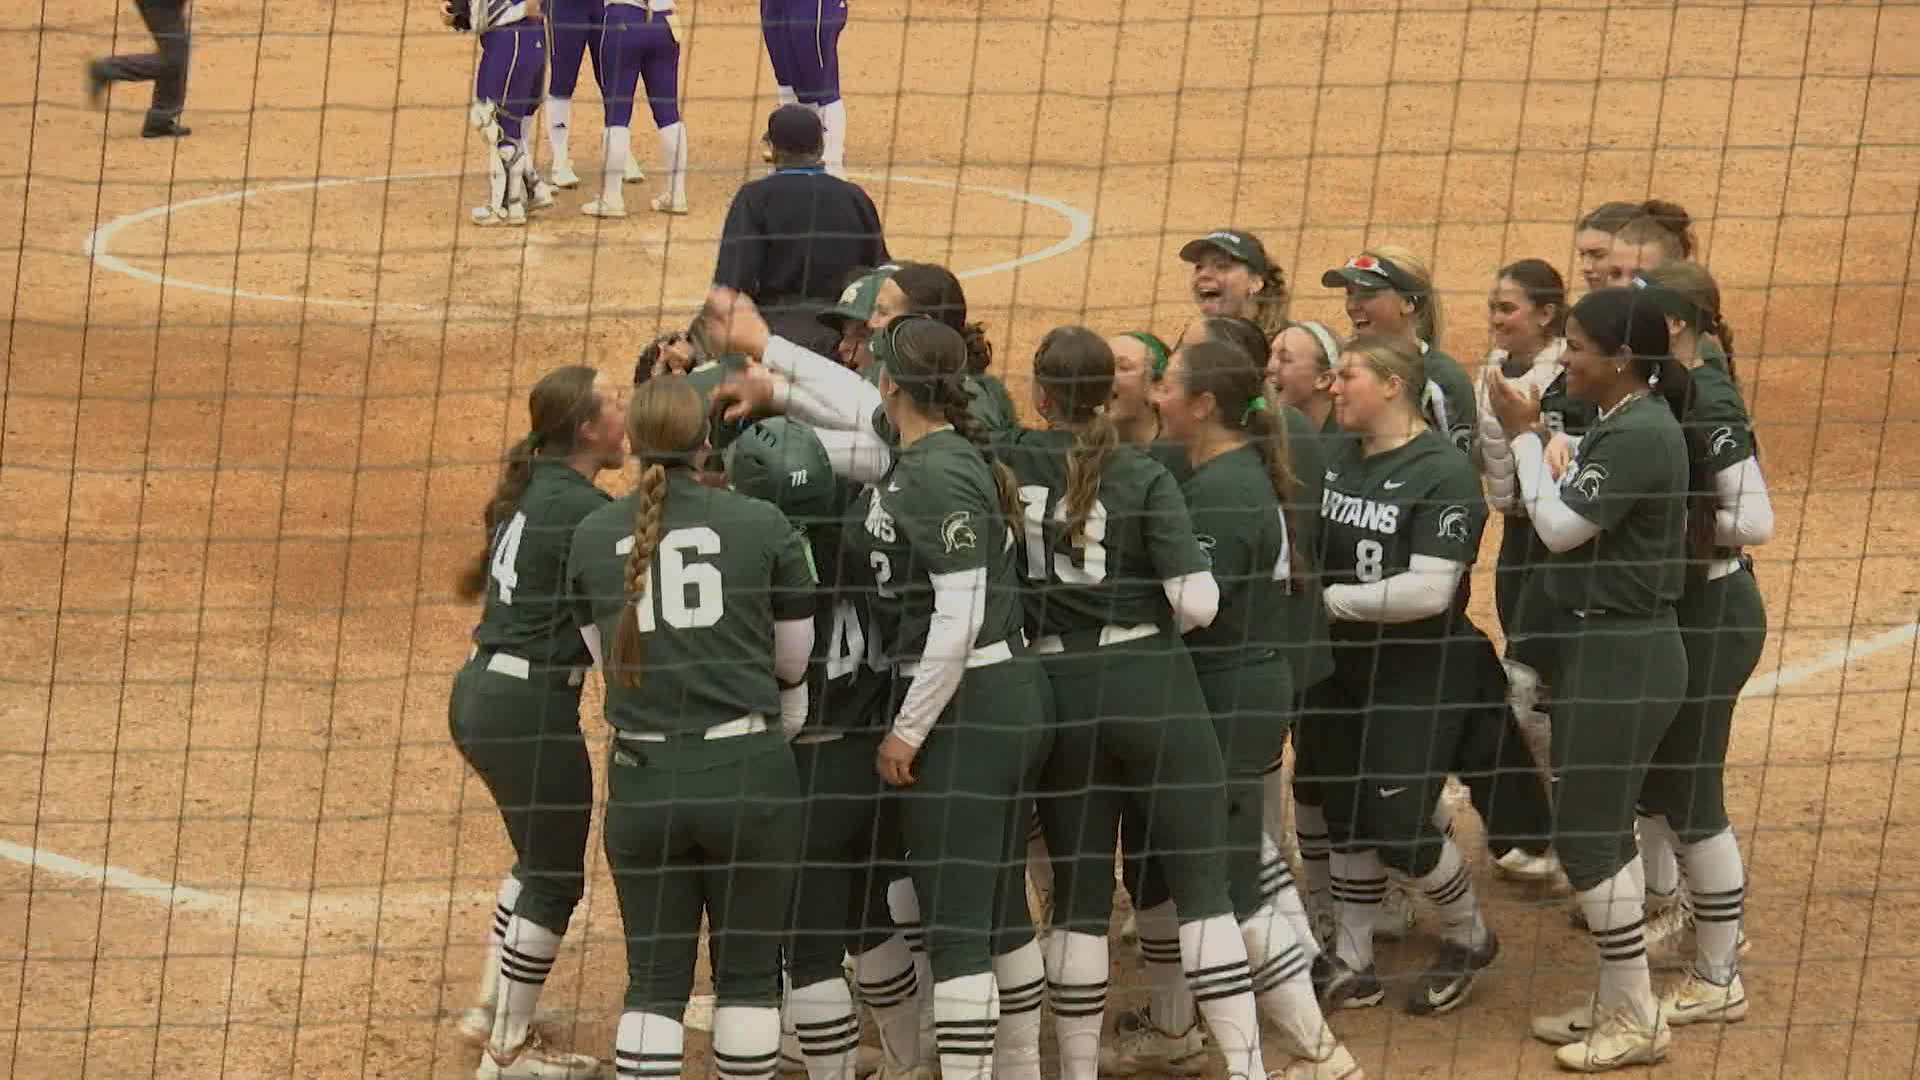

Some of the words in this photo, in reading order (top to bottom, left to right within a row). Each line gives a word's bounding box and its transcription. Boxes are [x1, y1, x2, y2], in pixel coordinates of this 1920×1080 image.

[615, 526, 724, 632] 16
[870, 550, 897, 598] 2
[1355, 538, 1384, 582] 8
